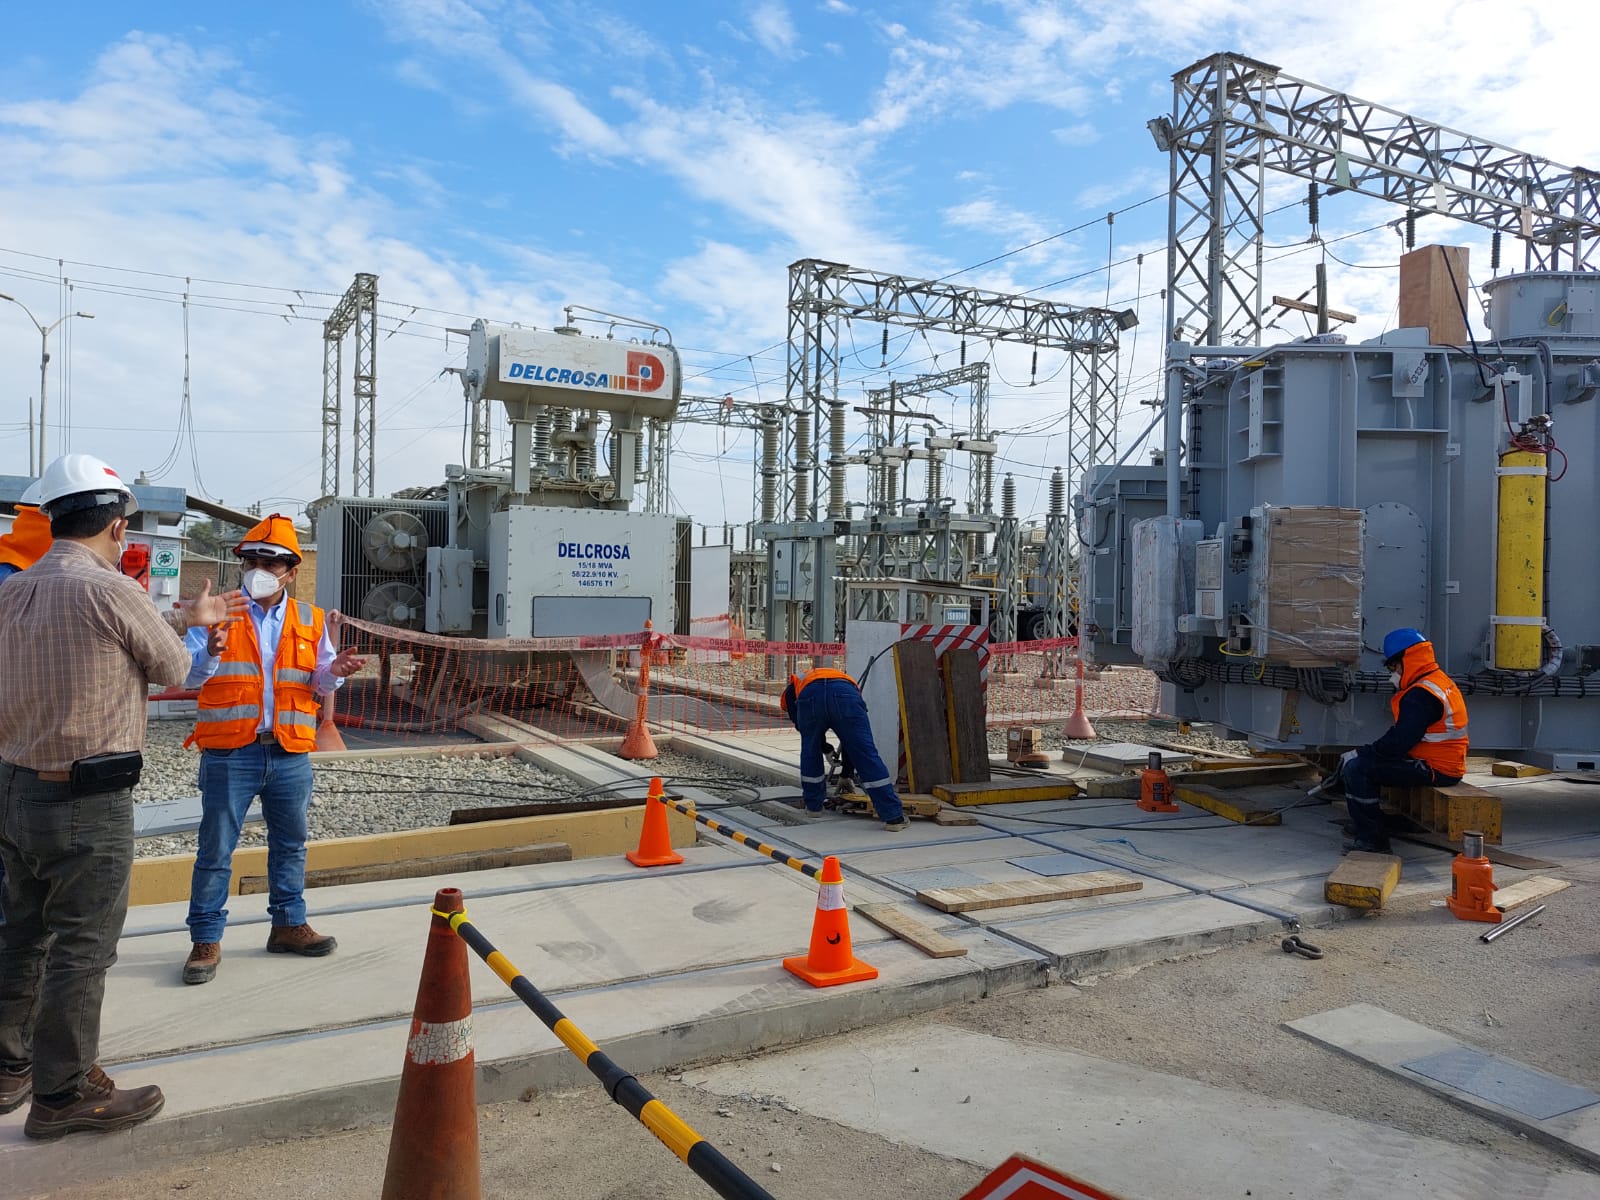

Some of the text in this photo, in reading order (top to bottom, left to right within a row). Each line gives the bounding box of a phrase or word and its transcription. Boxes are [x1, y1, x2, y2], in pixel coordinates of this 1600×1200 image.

[508, 363, 608, 388] DELCROSA
[558, 542, 631, 560] DELCROSA
[598, 562, 613, 570] MVA
[604, 580, 613, 588] T1
[709, 638, 733, 647] OBRAS
[745, 640, 769, 649] PELIGRO
[786, 642, 809, 650] OBRAS
[819, 643, 842, 651] PELIGRO
